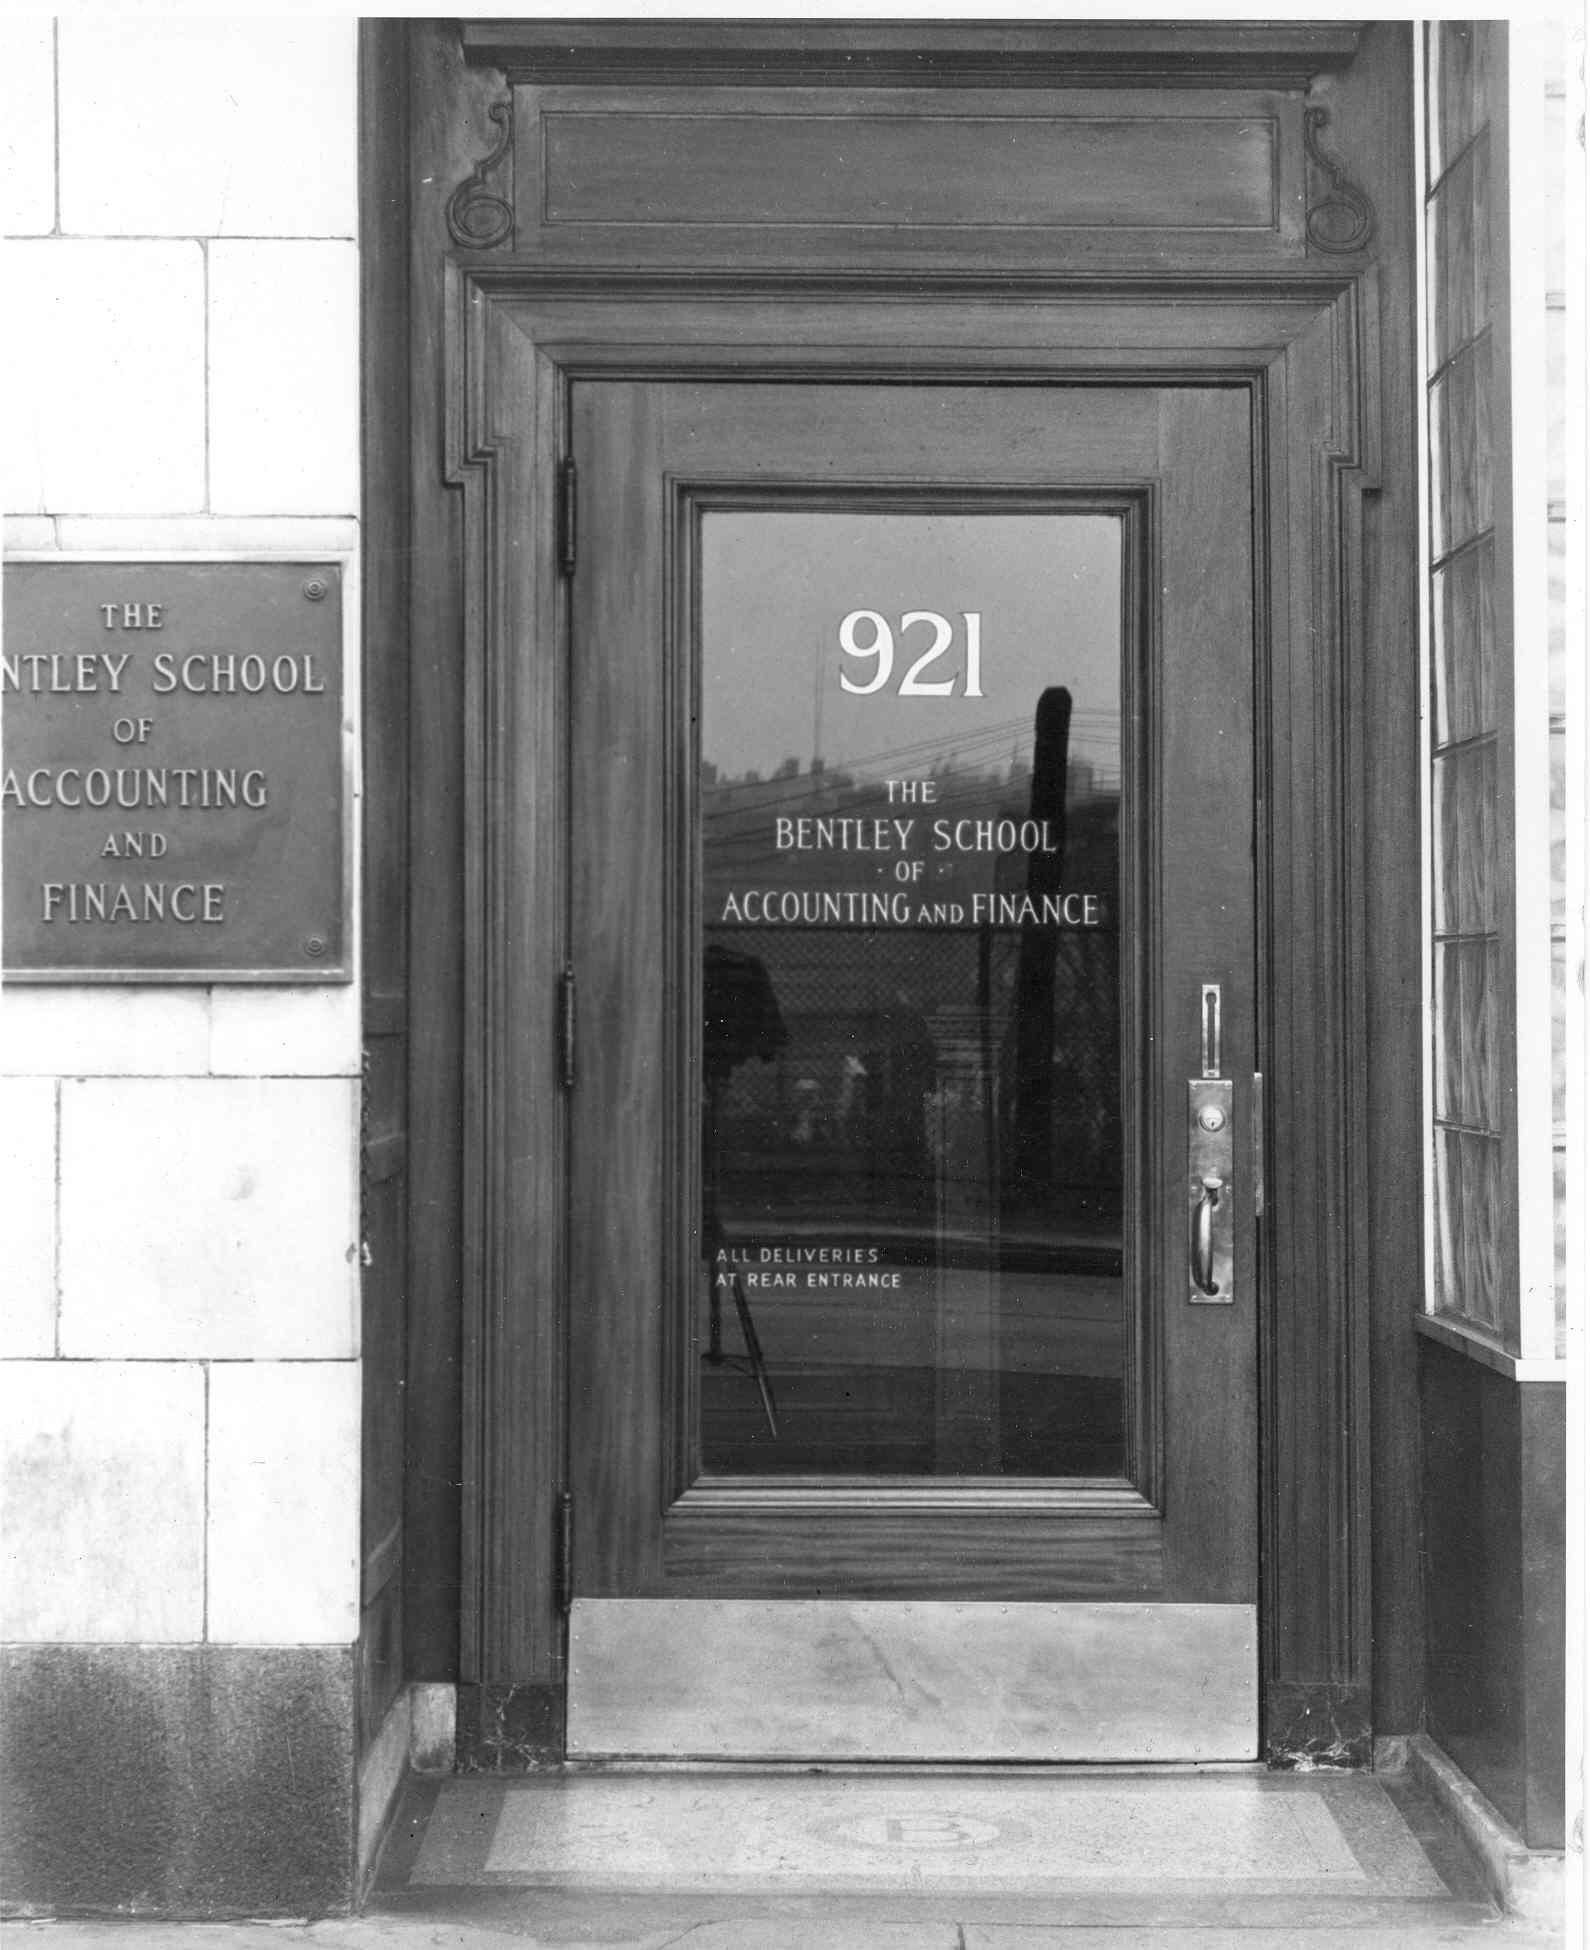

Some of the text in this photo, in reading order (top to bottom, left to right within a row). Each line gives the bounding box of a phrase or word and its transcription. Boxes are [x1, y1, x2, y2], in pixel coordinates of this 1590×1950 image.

[101, 604, 163, 628] THE
[839, 609, 984, 697] 921
[2, 654, 325, 692] NTLEY SCHOOL
[113, 718, 153, 742] OF
[2, 768, 267, 807] ACCOUNTING
[885, 781, 937, 803] THE
[101, 832, 167, 857] AND
[775, 818, 1057, 852] BENTLEY SCHOOL
[895, 861, 925, 882] OF
[42, 883, 225, 922] FINANCE
[722, 891, 1099, 925] ACCOUNTING AND FINANCE
[716, 1248, 878, 1263] ALL DELIVERIES
[715, 1273, 901, 1288] AT REAR ENTRANCE
